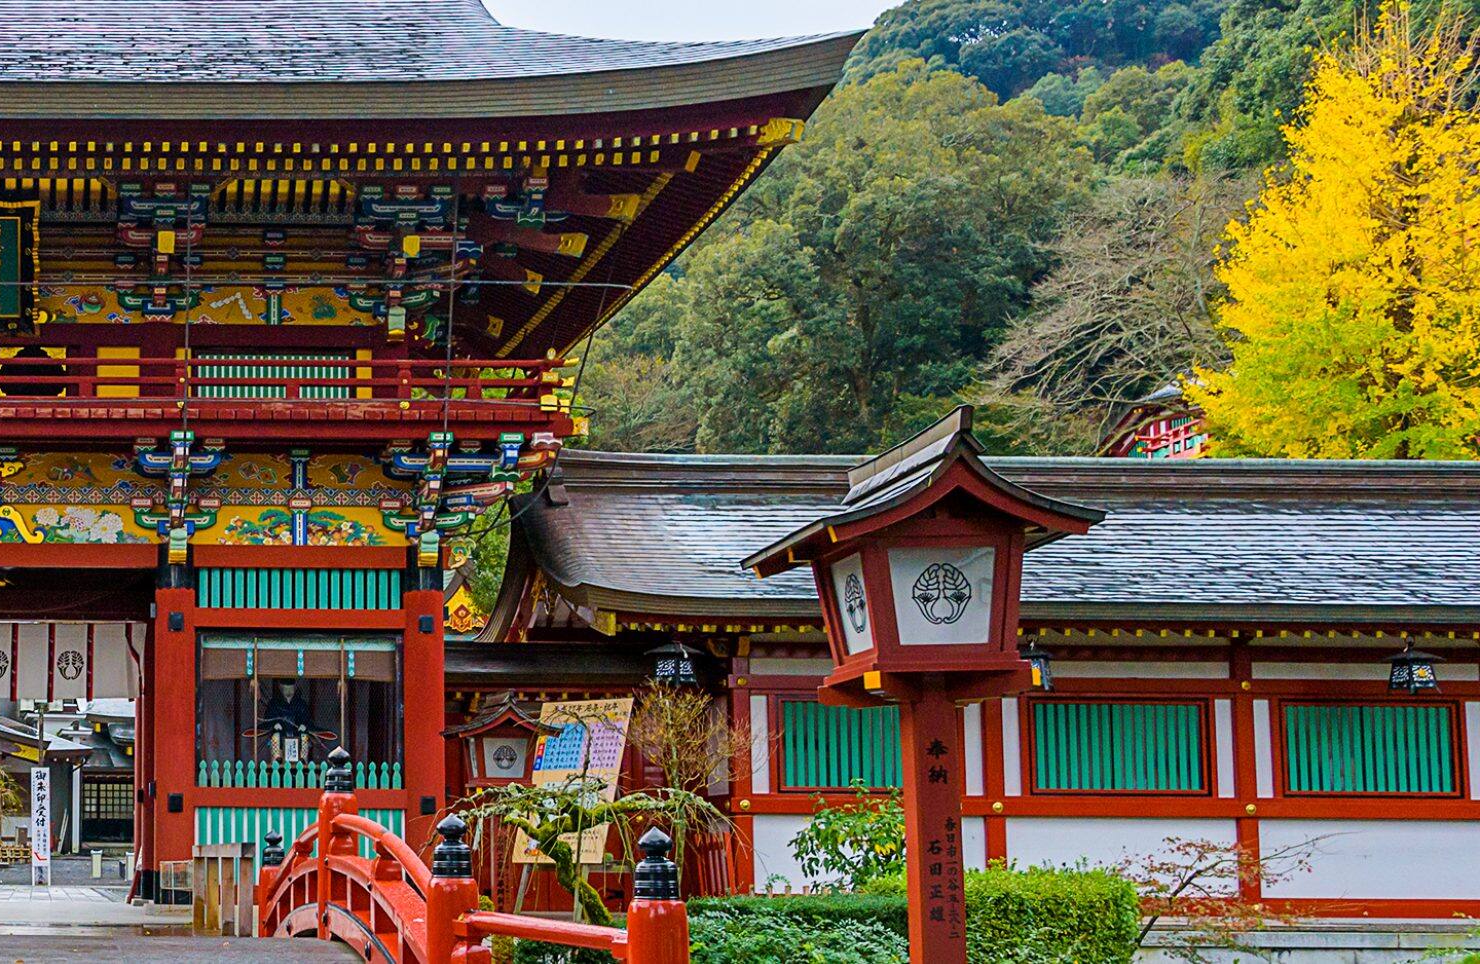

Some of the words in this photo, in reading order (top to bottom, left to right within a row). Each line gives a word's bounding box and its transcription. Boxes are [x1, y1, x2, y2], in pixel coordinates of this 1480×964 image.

[925, 738, 949, 784] 奉納
[35, 770, 47, 827] 御朱印受付
